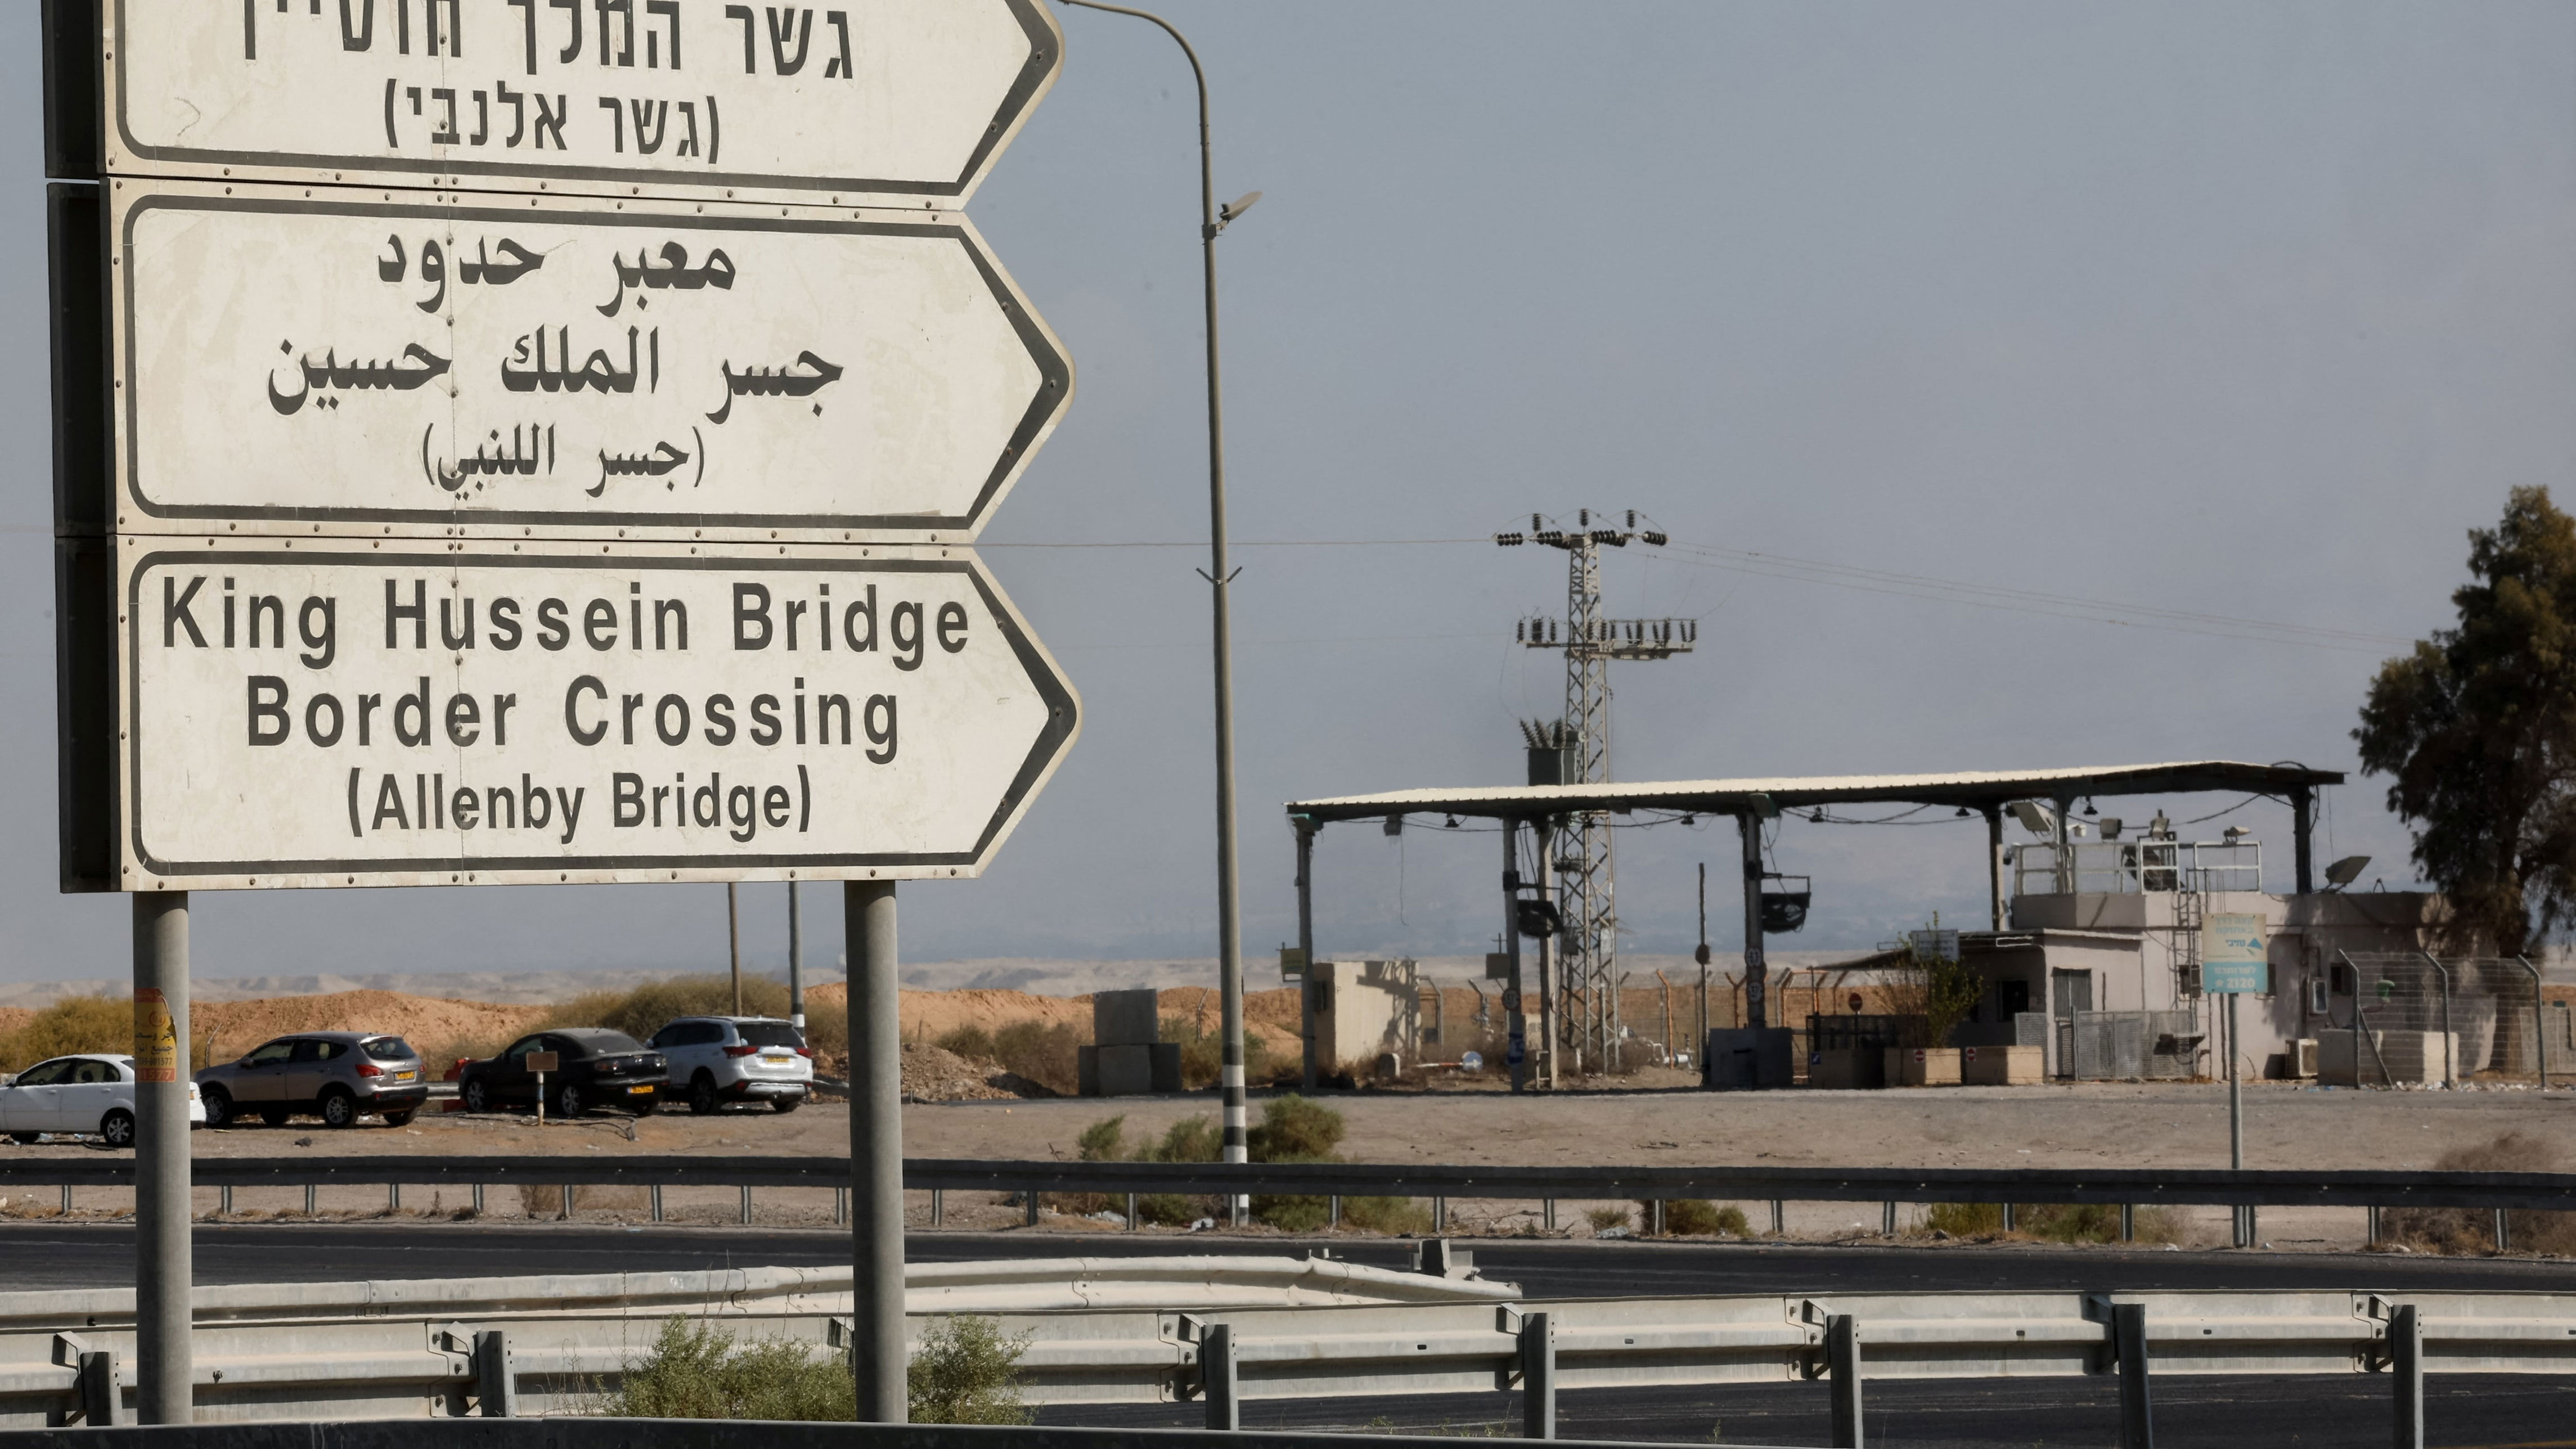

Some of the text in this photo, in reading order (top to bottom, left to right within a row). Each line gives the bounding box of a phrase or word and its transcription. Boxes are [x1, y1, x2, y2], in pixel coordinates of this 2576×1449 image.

[508, 0, 680, 75] המלך
[726, 4, 852, 79] גשר
[385, 79, 719, 164] (גשר אלנבי)
[379, 235, 735, 317] معبر حدود
[269, 325, 843, 424] جسر الملك حسين
[423, 423, 704, 500] (جسر اللنبي)
[164, 577, 968, 671] King Hussein Bridge
[248, 676, 897, 764] Border Crossing
[349, 765, 810, 844] (Allenby Bridge)
